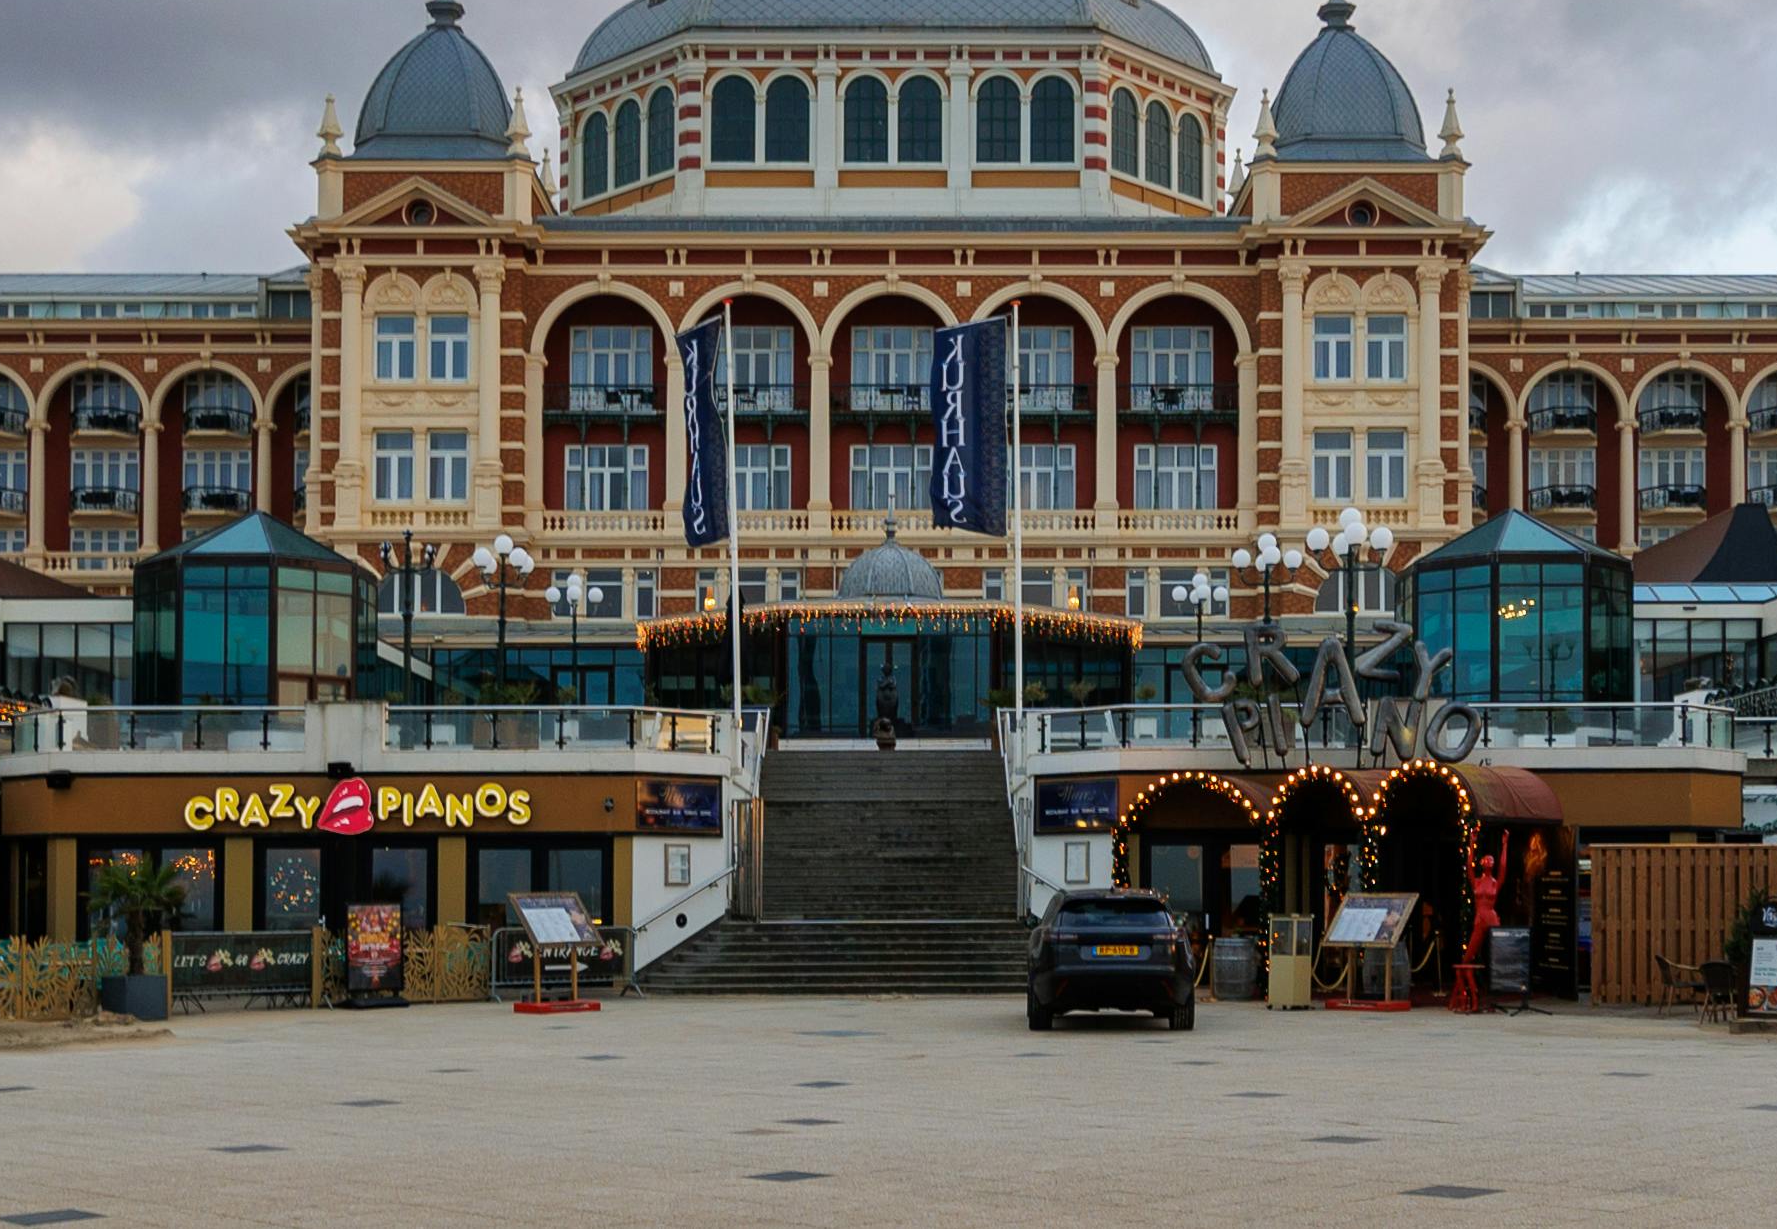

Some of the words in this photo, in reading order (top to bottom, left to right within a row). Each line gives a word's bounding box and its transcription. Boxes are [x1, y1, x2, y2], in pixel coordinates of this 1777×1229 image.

[1182, 621, 1453, 723] CRAZY
[184, 783, 321, 831] CRAZY
[377, 782, 533, 828] PIANOS
[174, 954, 207, 968] LET'S
[235, 954, 249, 967] GO
[277, 952, 310, 966] CRAZY
